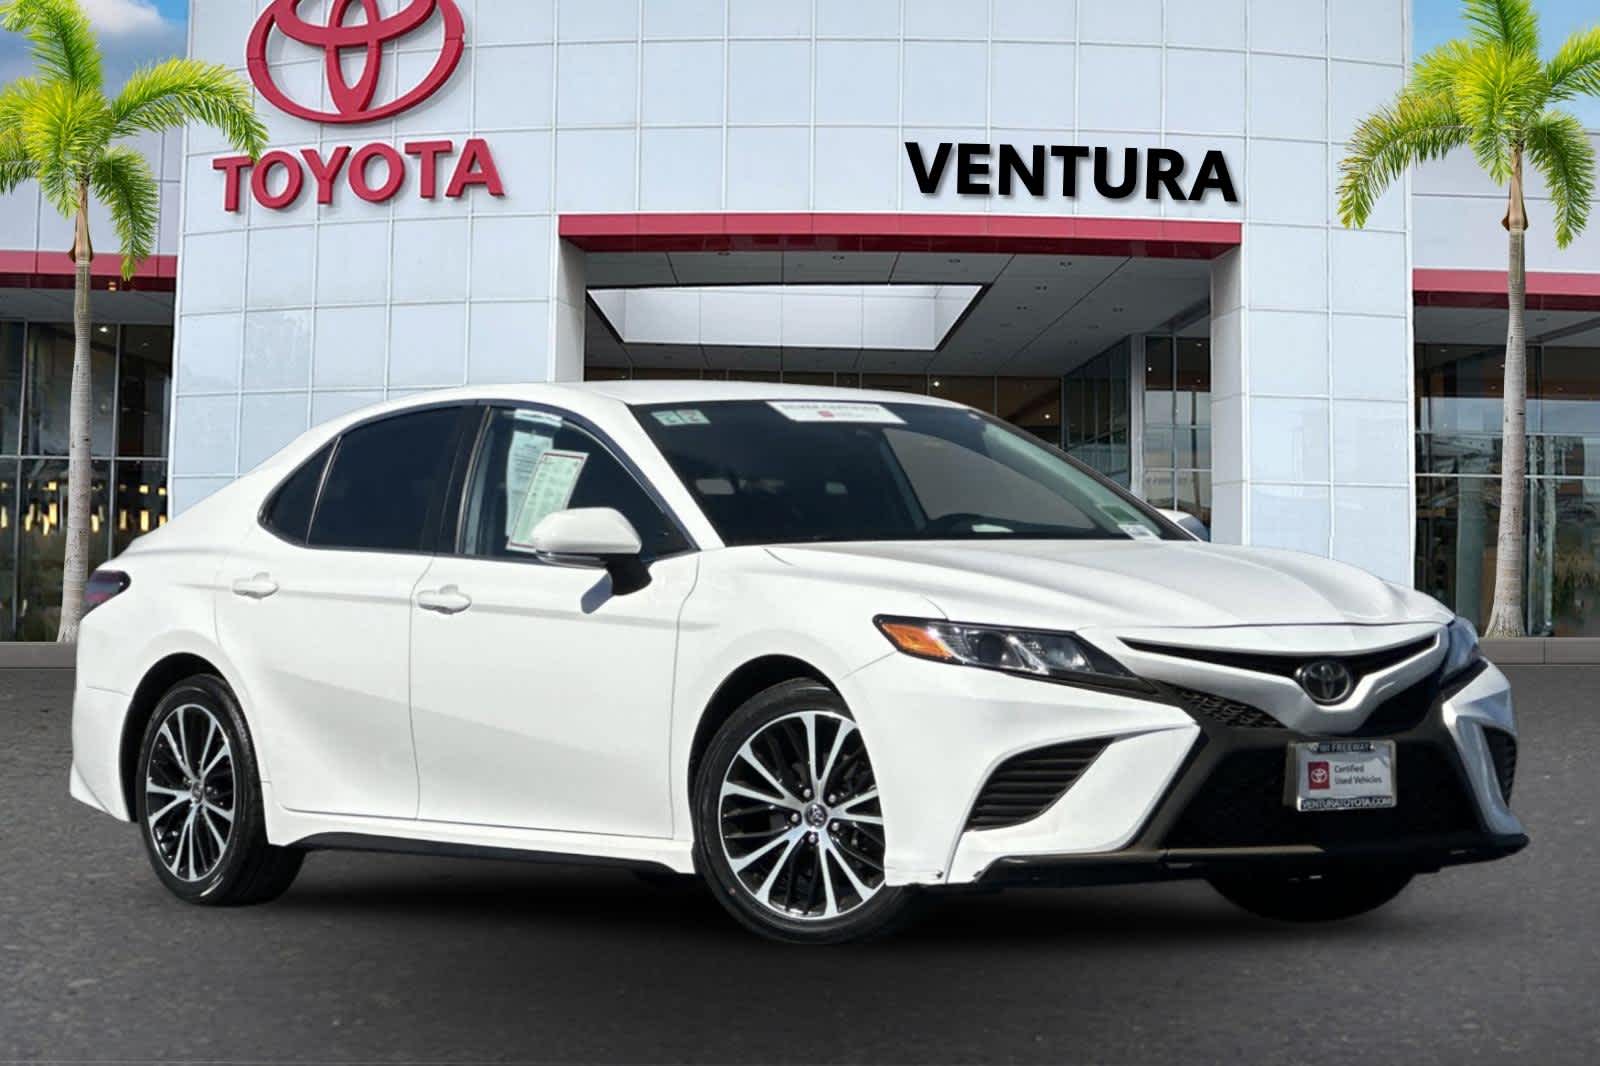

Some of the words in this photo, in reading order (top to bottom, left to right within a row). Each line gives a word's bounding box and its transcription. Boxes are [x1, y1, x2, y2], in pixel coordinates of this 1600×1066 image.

[212, 139, 505, 212] TOYOTA
[905, 142, 1238, 203] VENTURA
[1334, 764, 1364, 773] Certified
[1334, 775, 1352, 784] Used
[1354, 775, 1383, 784] Vehicles
